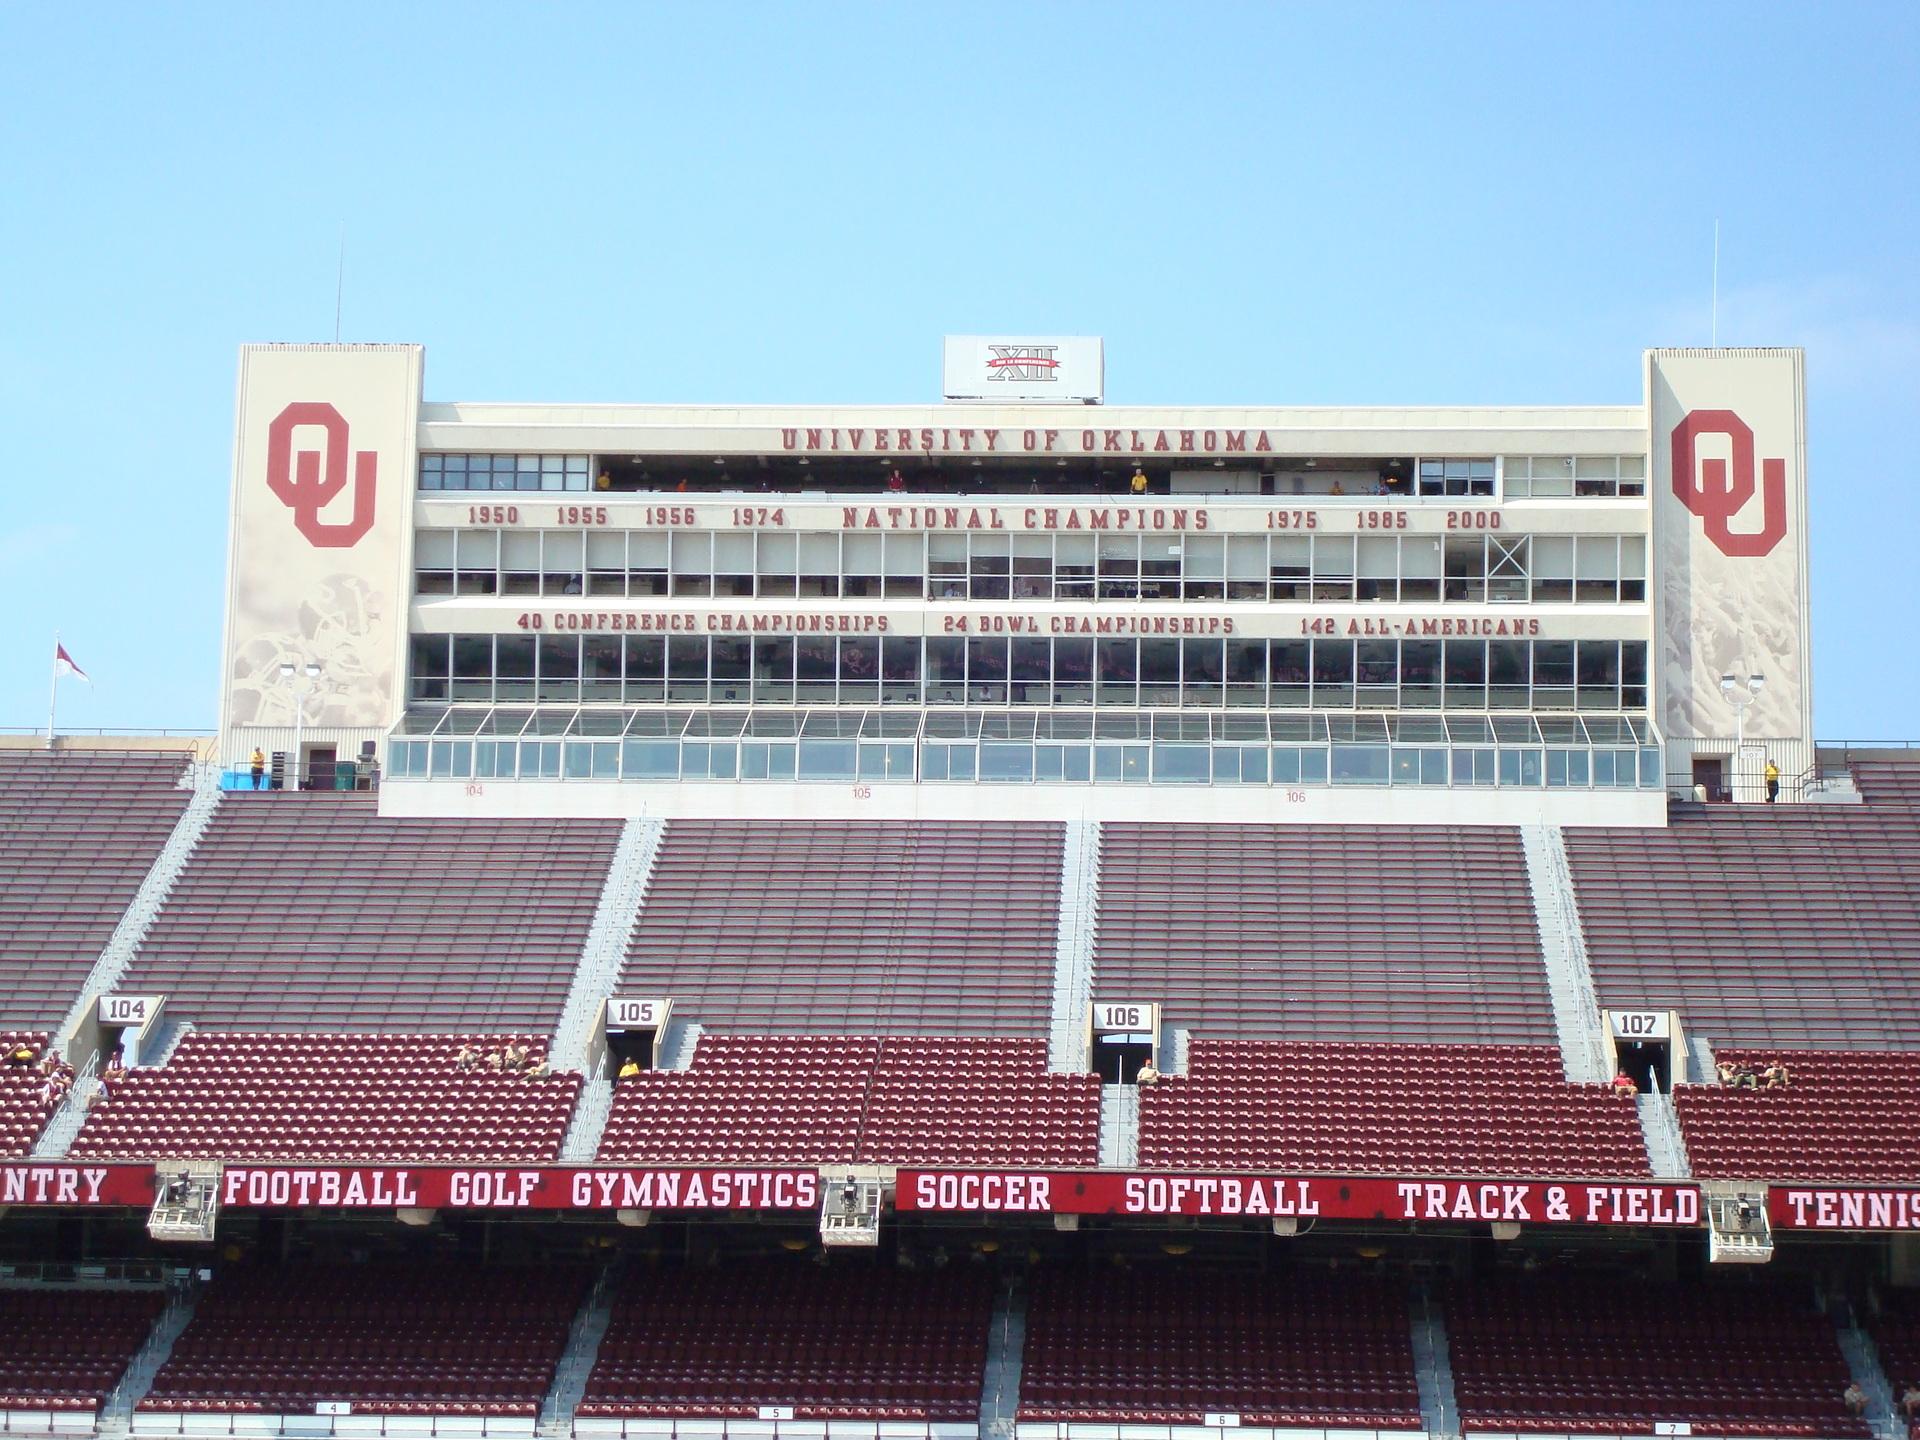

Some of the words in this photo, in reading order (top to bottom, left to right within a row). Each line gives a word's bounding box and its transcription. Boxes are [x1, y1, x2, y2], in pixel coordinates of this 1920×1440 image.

[987, 345, 1058, 381] XII
[782, 429, 999, 451] UNIVERSITY
[1023, 430, 1059, 451] OF
[1082, 430, 1272, 452] OKLAHOMA
[267, 402, 377, 548] OU
[1671, 409, 1787, 557] OU
[469, 506, 518, 523] 1950
[557, 506, 606, 525] 1955
[645, 507, 695, 525] 1956
[732, 507, 784, 526] 1974
[842, 508, 1003, 529] NATIONAL
[1023, 508, 1209, 530] CHAMPIONS
[1267, 511, 1317, 529] 1975
[1357, 511, 1407, 529] 1985
[1447, 511, 1500, 529] 2000
[517, 613, 542, 629] 40
[554, 613, 696, 630] CONFERENCE
[706, 614, 888, 632] CHAMPIONSHIPS
[943, 615, 968, 632] 24
[980, 615, 1038, 632] BOWL
[1050, 615, 1235, 633] CHAMPIONSHIPS
[1301, 617, 1336, 634] 142
[1347, 618, 1540, 635] ALL-AMERICANS
[464, 785, 483, 797] 104
[852, 787, 871, 799] 105
[1286, 791, 1306, 803] 106
[109, 1000, 145, 1019] 104
[618, 1003, 653, 1023] 105
[1105, 1008, 1140, 1027] 106
[1620, 1016, 1656, 1035] 107
[0, 1167, 107, 1203] NTRY
[225, 1170, 417, 1206] FOOTBALL
[450, 1171, 540, 1207] GOLF
[572, 1171, 817, 1209] GYMNASTICS
[917, 1174, 1051, 1211] SOCCER
[1125, 1178, 1320, 1216] SOFTBALL
[1398, 1182, 1531, 1220] TRACK
[1546, 1186, 1571, 1221] &
[1586, 1186, 1699, 1223] FIELD
[330, 1403, 337, 1412] 4
[773, 1408, 780, 1418] 5
[1219, 1415, 1225, 1425] 6
[1670, 1424, 1676, 1433] 7
